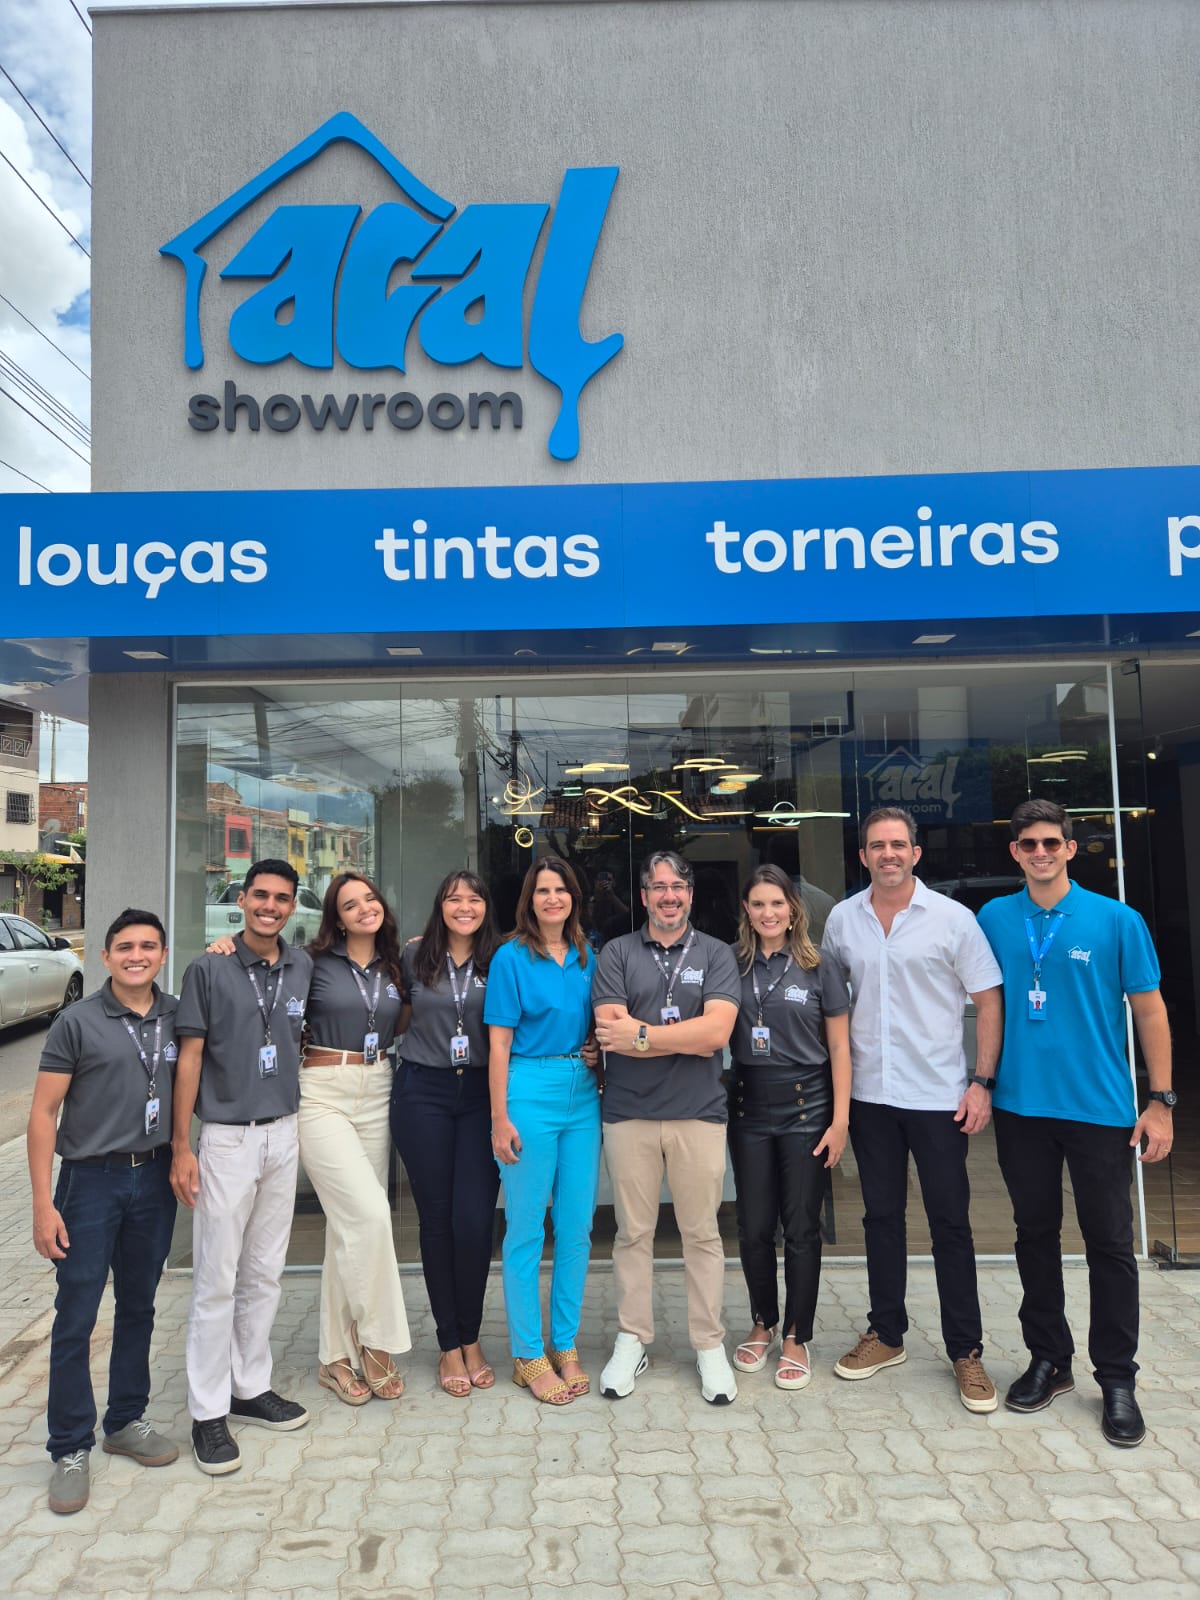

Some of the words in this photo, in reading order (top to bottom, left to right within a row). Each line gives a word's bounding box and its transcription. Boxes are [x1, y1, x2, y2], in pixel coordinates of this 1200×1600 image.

[188, 380, 523, 434] showroom
[19, 526, 268, 599] louças
[375, 519, 600, 581] tintas
[706, 506, 1060, 574] torneiras
